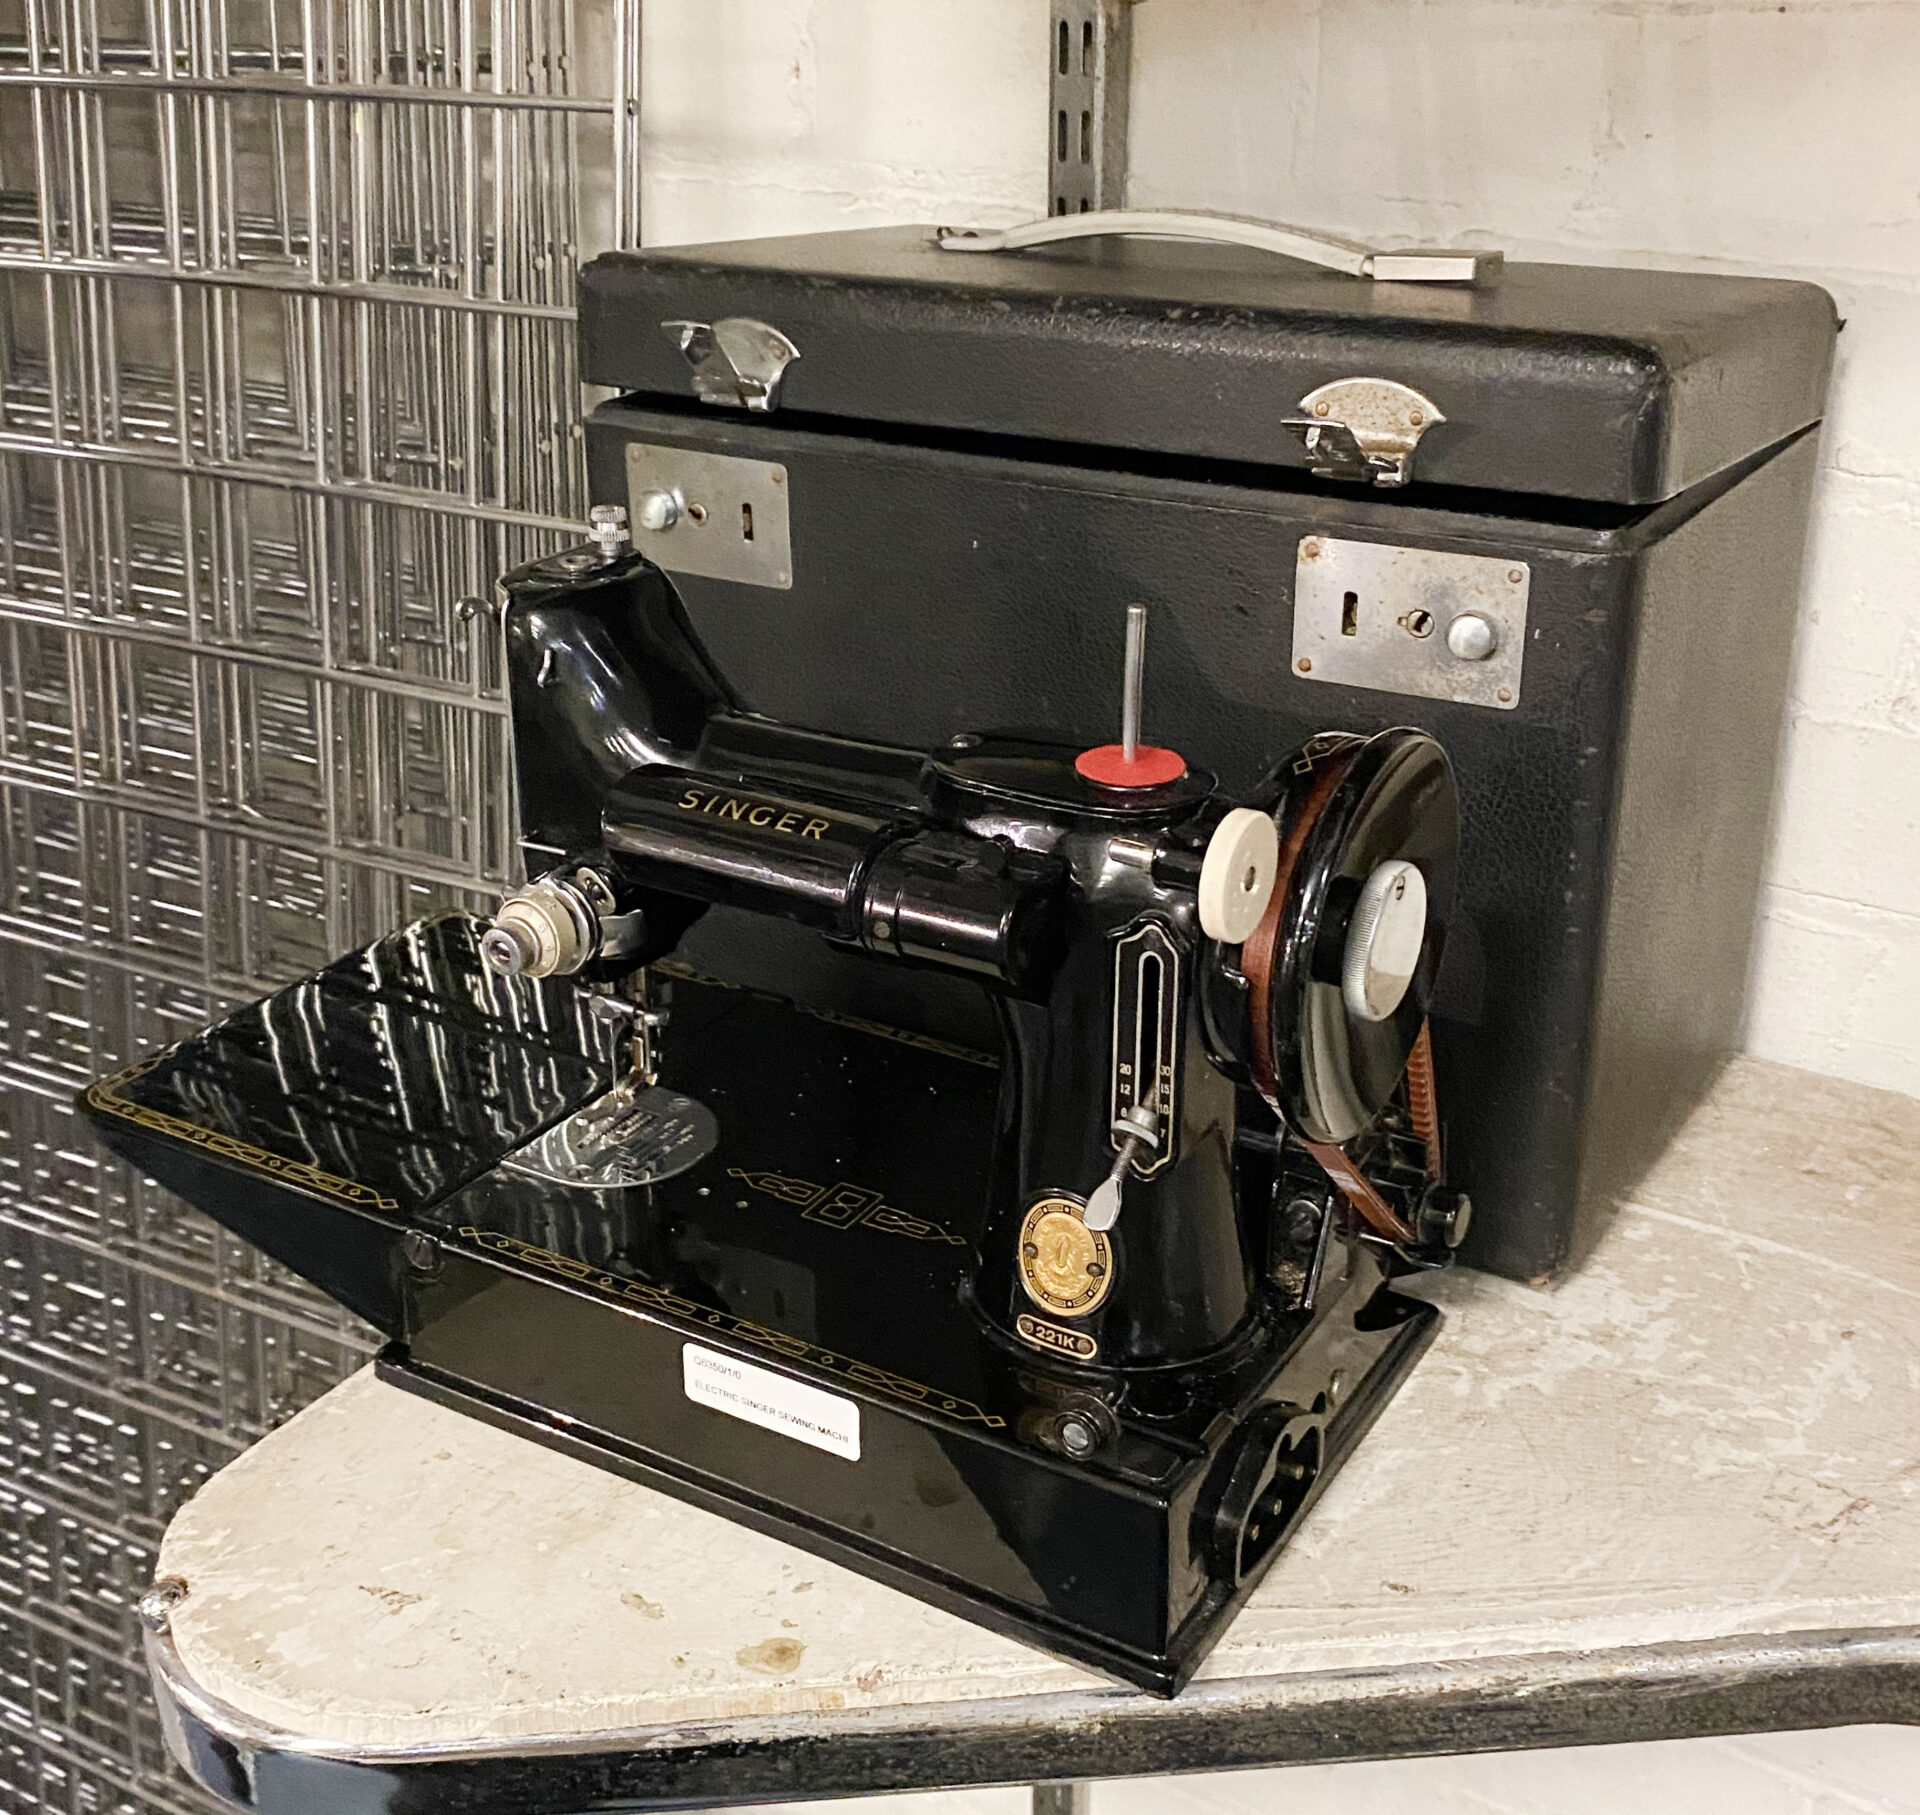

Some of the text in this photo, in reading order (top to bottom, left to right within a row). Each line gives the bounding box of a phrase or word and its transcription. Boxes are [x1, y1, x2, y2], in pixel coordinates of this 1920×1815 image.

[678, 790, 830, 840] SINGER
[1119, 1063, 1132, 1076] 20
[1160, 1065, 1172, 1077] 30
[1120, 1083, 1131, 1095] 12
[1160, 1083, 1170, 1095] 15
[1035, 1326, 1075, 1349] 221K
[694, 1379, 849, 1444] ELECTRIC SINGER SEWING MACHI
